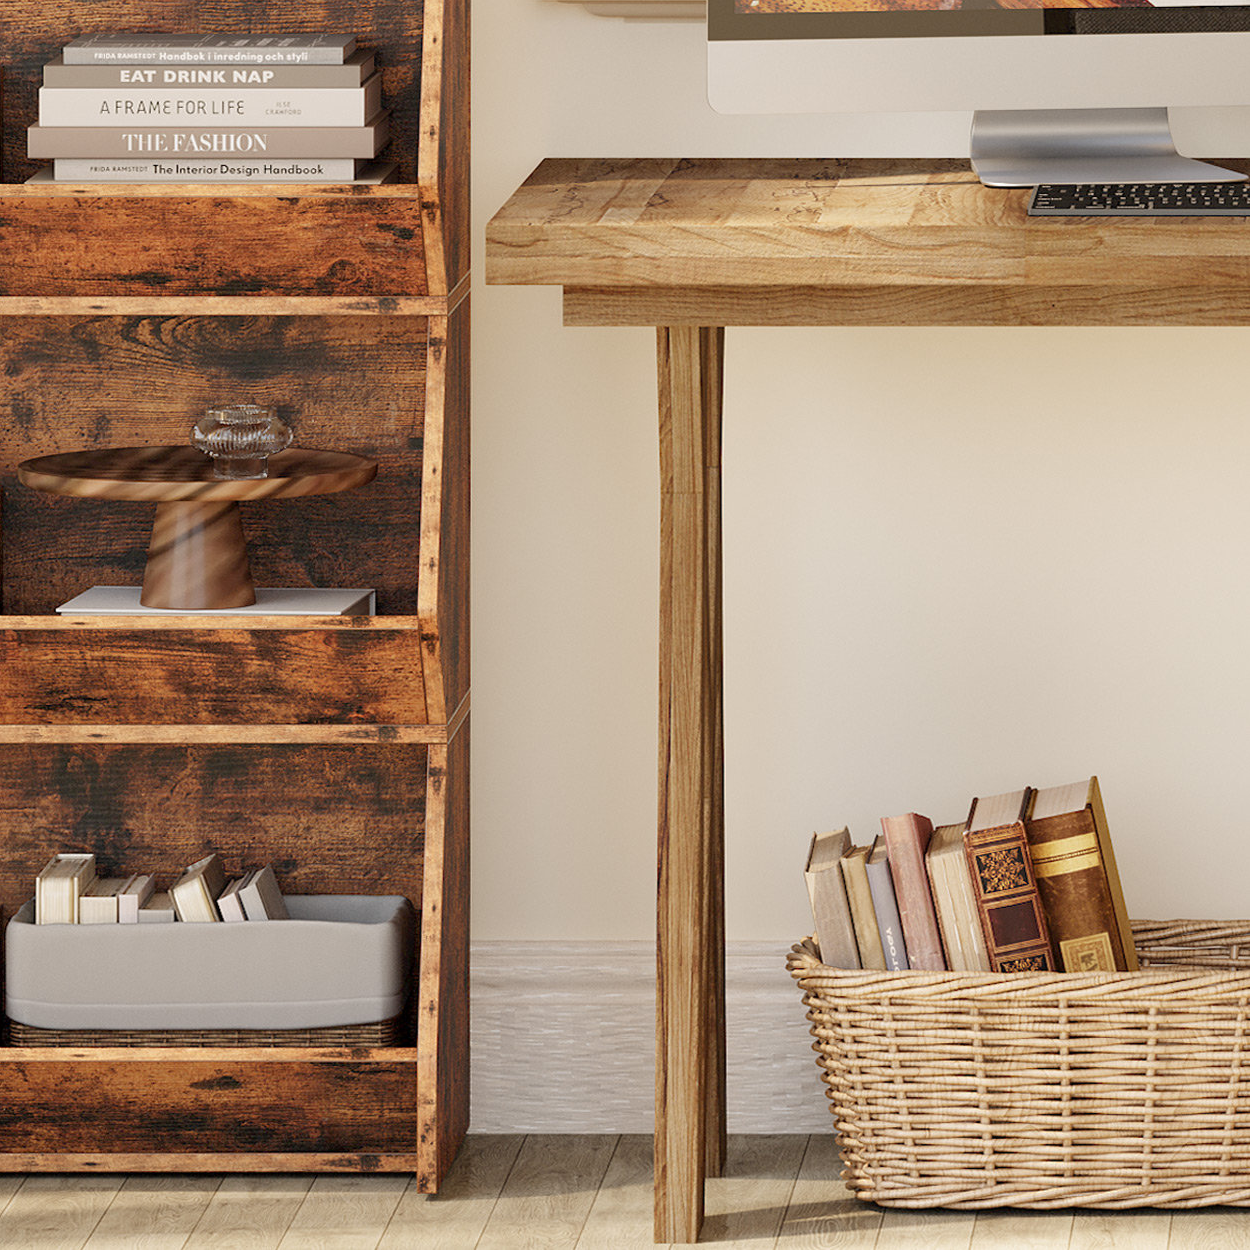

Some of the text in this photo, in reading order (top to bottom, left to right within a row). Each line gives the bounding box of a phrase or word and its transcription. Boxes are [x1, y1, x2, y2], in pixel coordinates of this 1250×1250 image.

[158, 52, 205, 61] Handbok
[213, 52, 264, 64] inredning
[266, 52, 283, 61] och
[120, 70, 275, 84] EAT DRINK NAP
[100, 101, 244, 116] A FRAME FOR LIFE
[122, 134, 268, 152] THE FASHION
[153, 164, 173, 175] The
[175, 164, 217, 175] Interior
[220, 164, 260, 178] Design
[264, 164, 324, 175] Handbook
